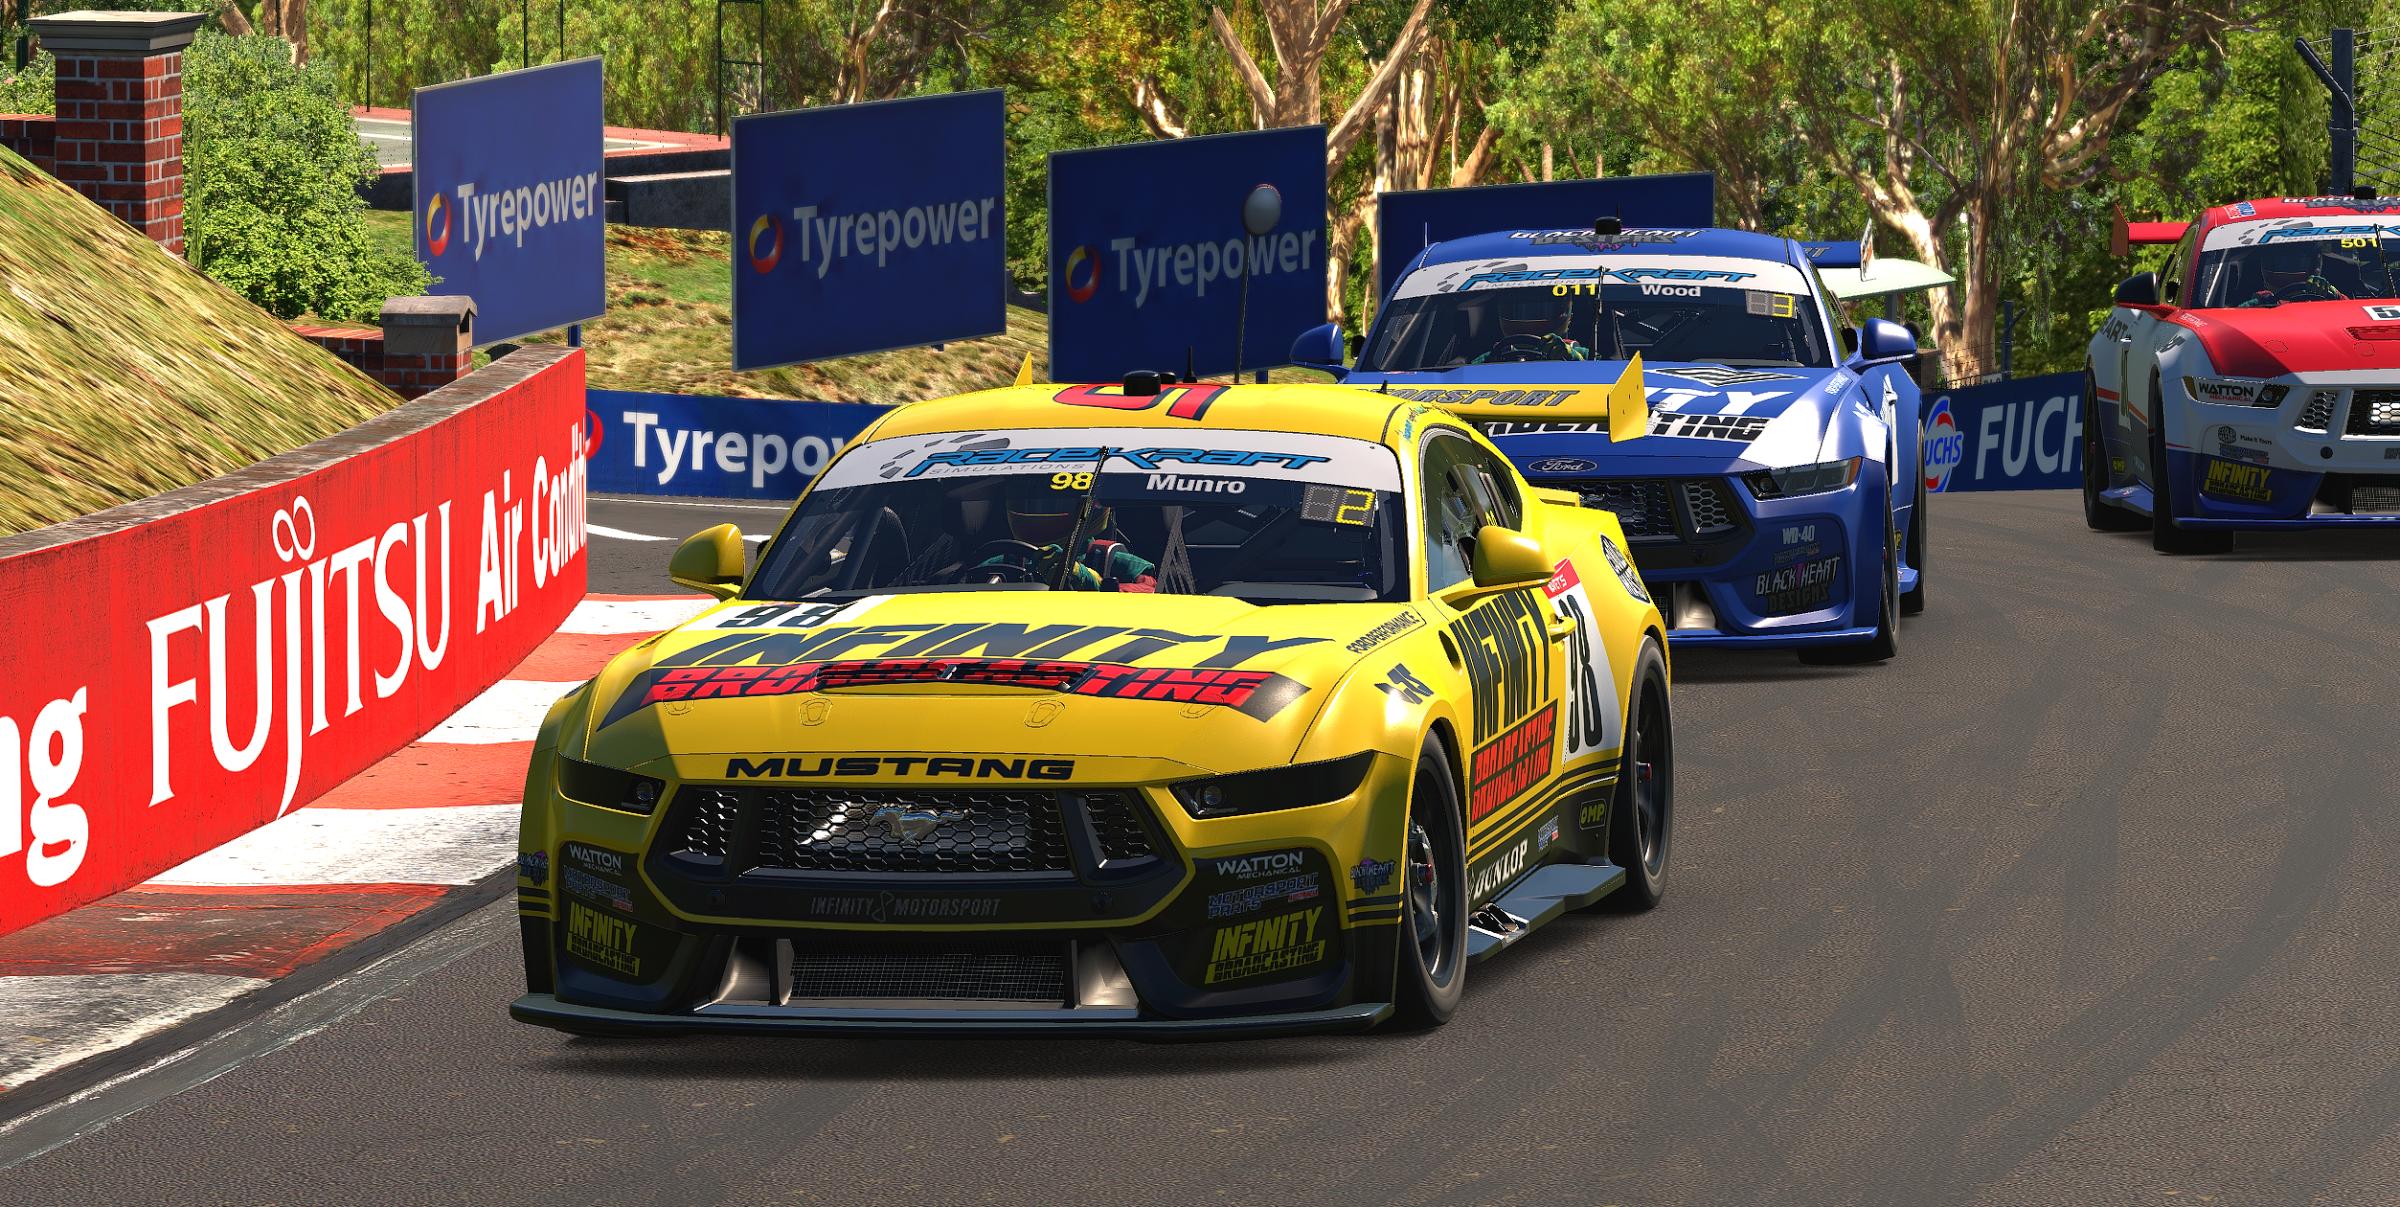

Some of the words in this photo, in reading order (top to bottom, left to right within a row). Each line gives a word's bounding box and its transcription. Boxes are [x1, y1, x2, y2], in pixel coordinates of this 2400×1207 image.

[457, 170, 598, 261] Tyrepower
[794, 196, 995, 279] Tyrepower
[2341, 237, 2378, 249] 501
[1111, 229, 1317, 309] Tyrepower
[1552, 283, 1597, 298] 011
[1641, 283, 1701, 298] Wood
[2199, 382, 2254, 398] WATTON
[928, 463, 1087, 476] SIMULATIONS
[1542, 460, 1584, 472] Ford
[2207, 459, 2272, 489] INFINITY
[1050, 472, 1094, 491] 98
[1146, 472, 1247, 494] Munro
[1336, 490, 1377, 526] 2
[1782, 525, 1816, 545] WD-40
[476, 469, 522, 635] Air
[1756, 567, 1795, 596] BLACK
[1800, 556, 1841, 589] HEART
[715, 603, 840, 629] 98
[652, 623, 1335, 668] INFINITY
[146, 500, 452, 819] FUJITSU
[1448, 588, 1549, 748] INFINITY
[1559, 594, 1603, 754] 98
[726, 757, 1075, 781] MUSTANG
[1581, 803, 1605, 824] OMP
[569, 844, 622, 869] WATTON
[1216, 851, 1303, 876] WATTON
[1474, 838, 1528, 900] DUNLOP
[1237, 867, 1301, 880] MECHANICAL
[1208, 871, 1319, 908] MOTORSPORT
[810, 897, 875, 915] INFINITY
[894, 898, 1001, 916] MOTORSPORT
[569, 901, 638, 954] INFINITY
[1210, 906, 1323, 963] INFINITY
